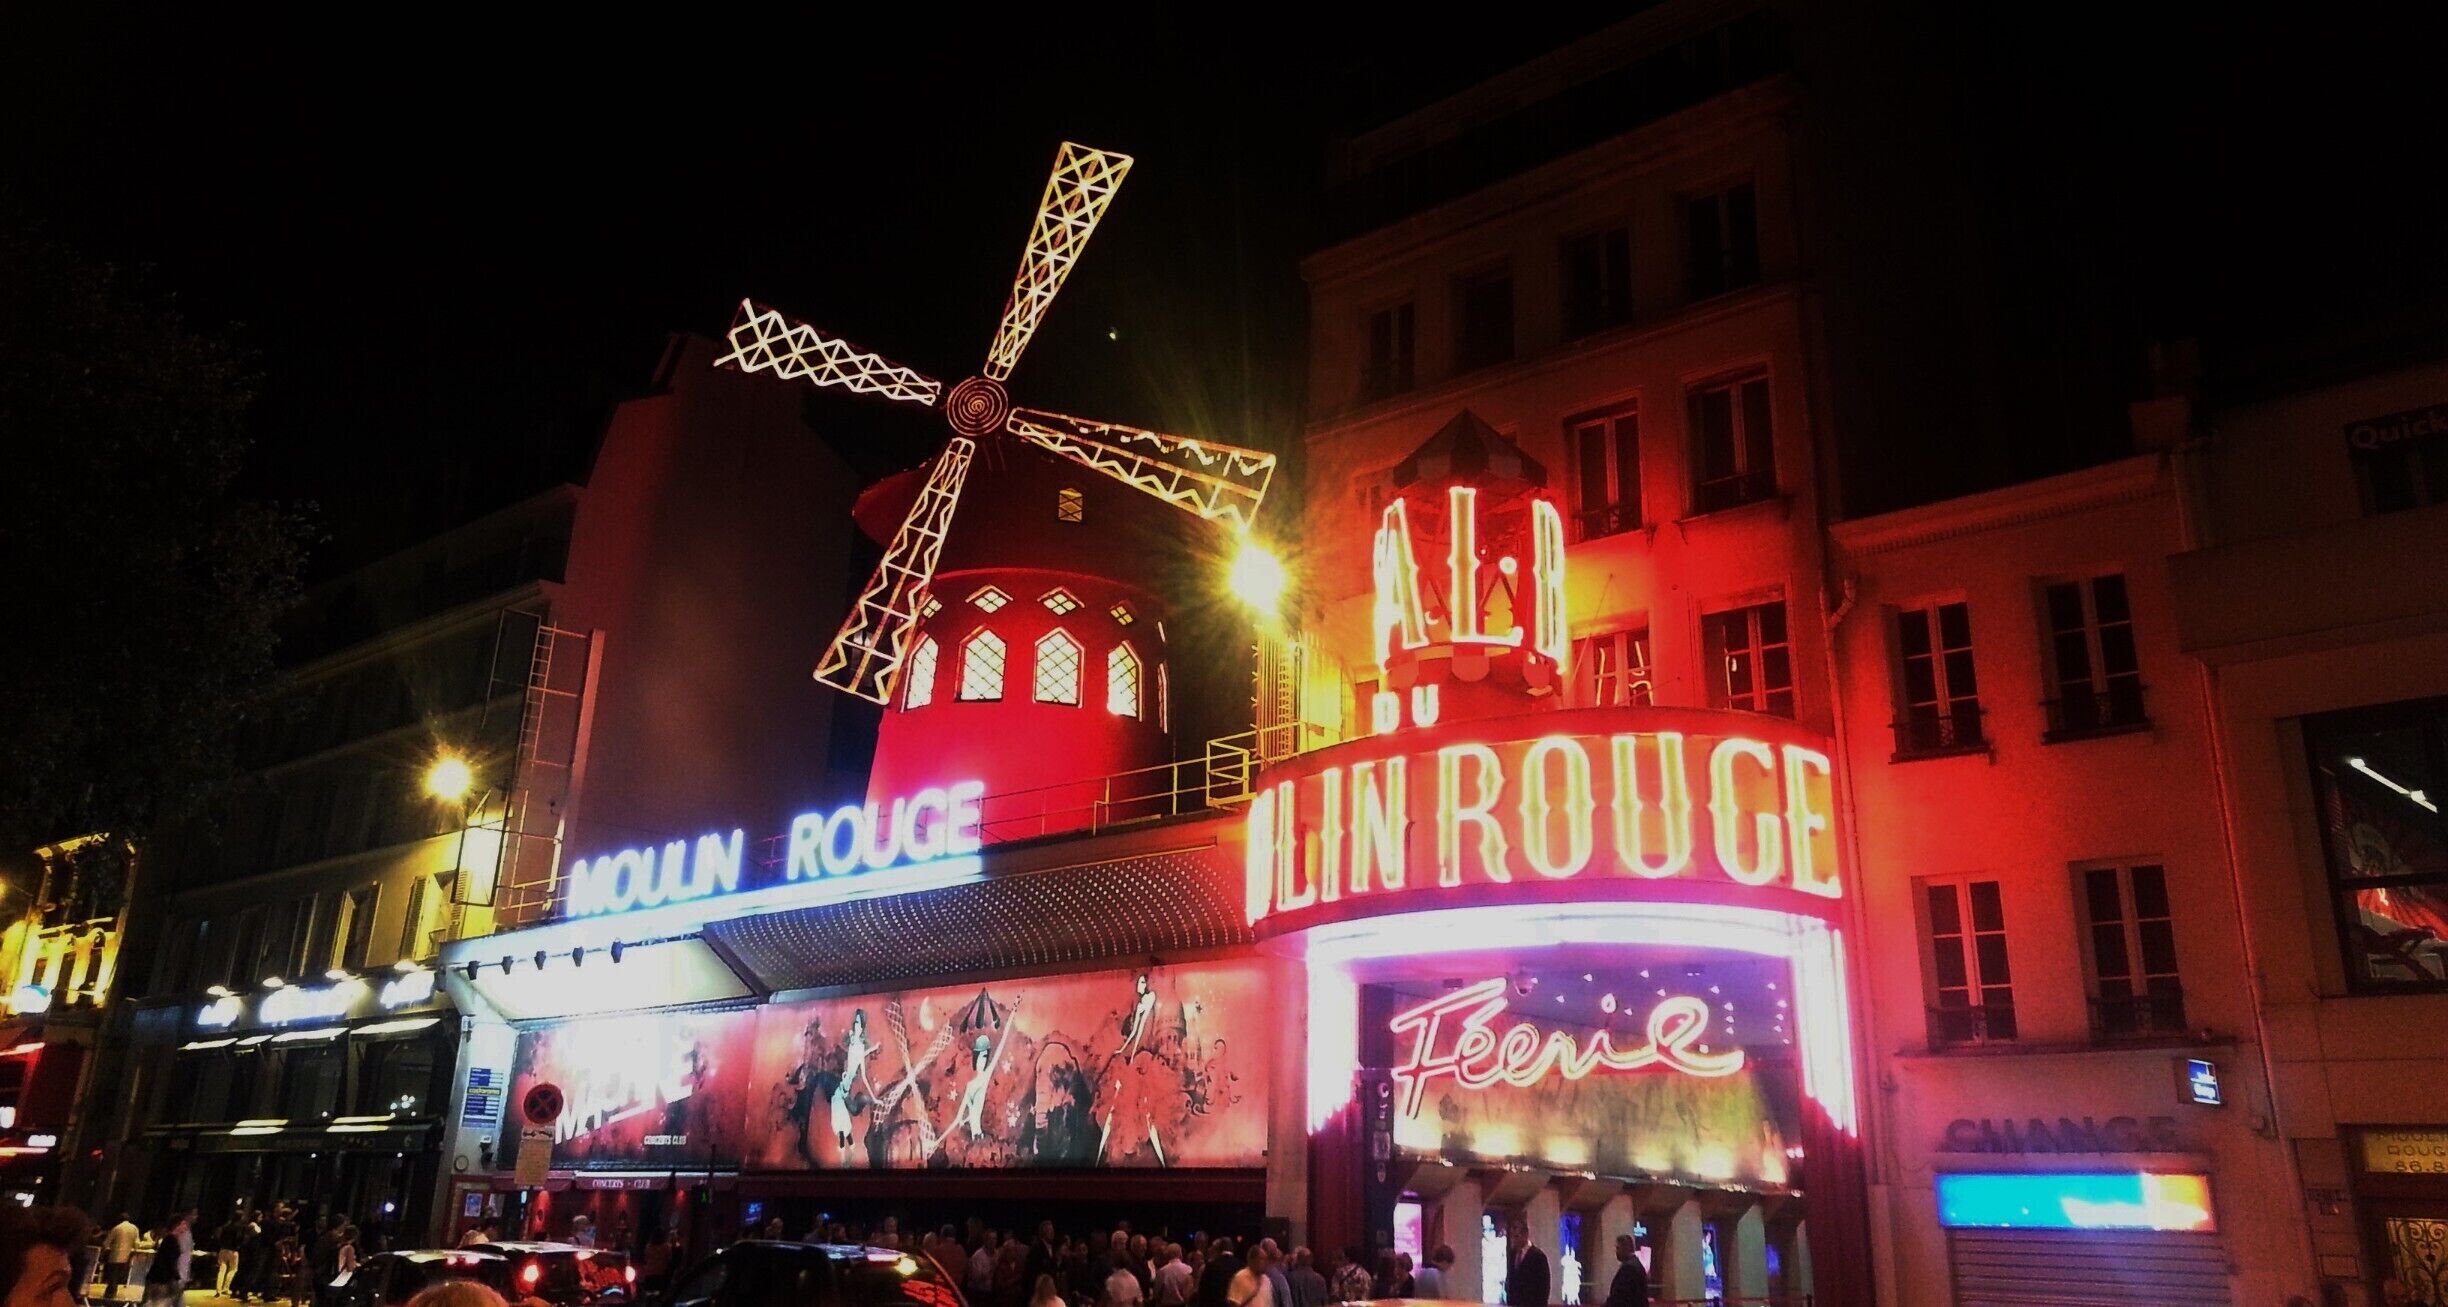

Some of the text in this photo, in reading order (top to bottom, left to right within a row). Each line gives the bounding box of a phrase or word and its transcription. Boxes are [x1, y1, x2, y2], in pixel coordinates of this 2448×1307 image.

[567, 780, 985, 919] MOULIN ROUGE
[1437, 732, 1842, 900] ROUGE
[1946, 1115, 2177, 1154] CHANGE
